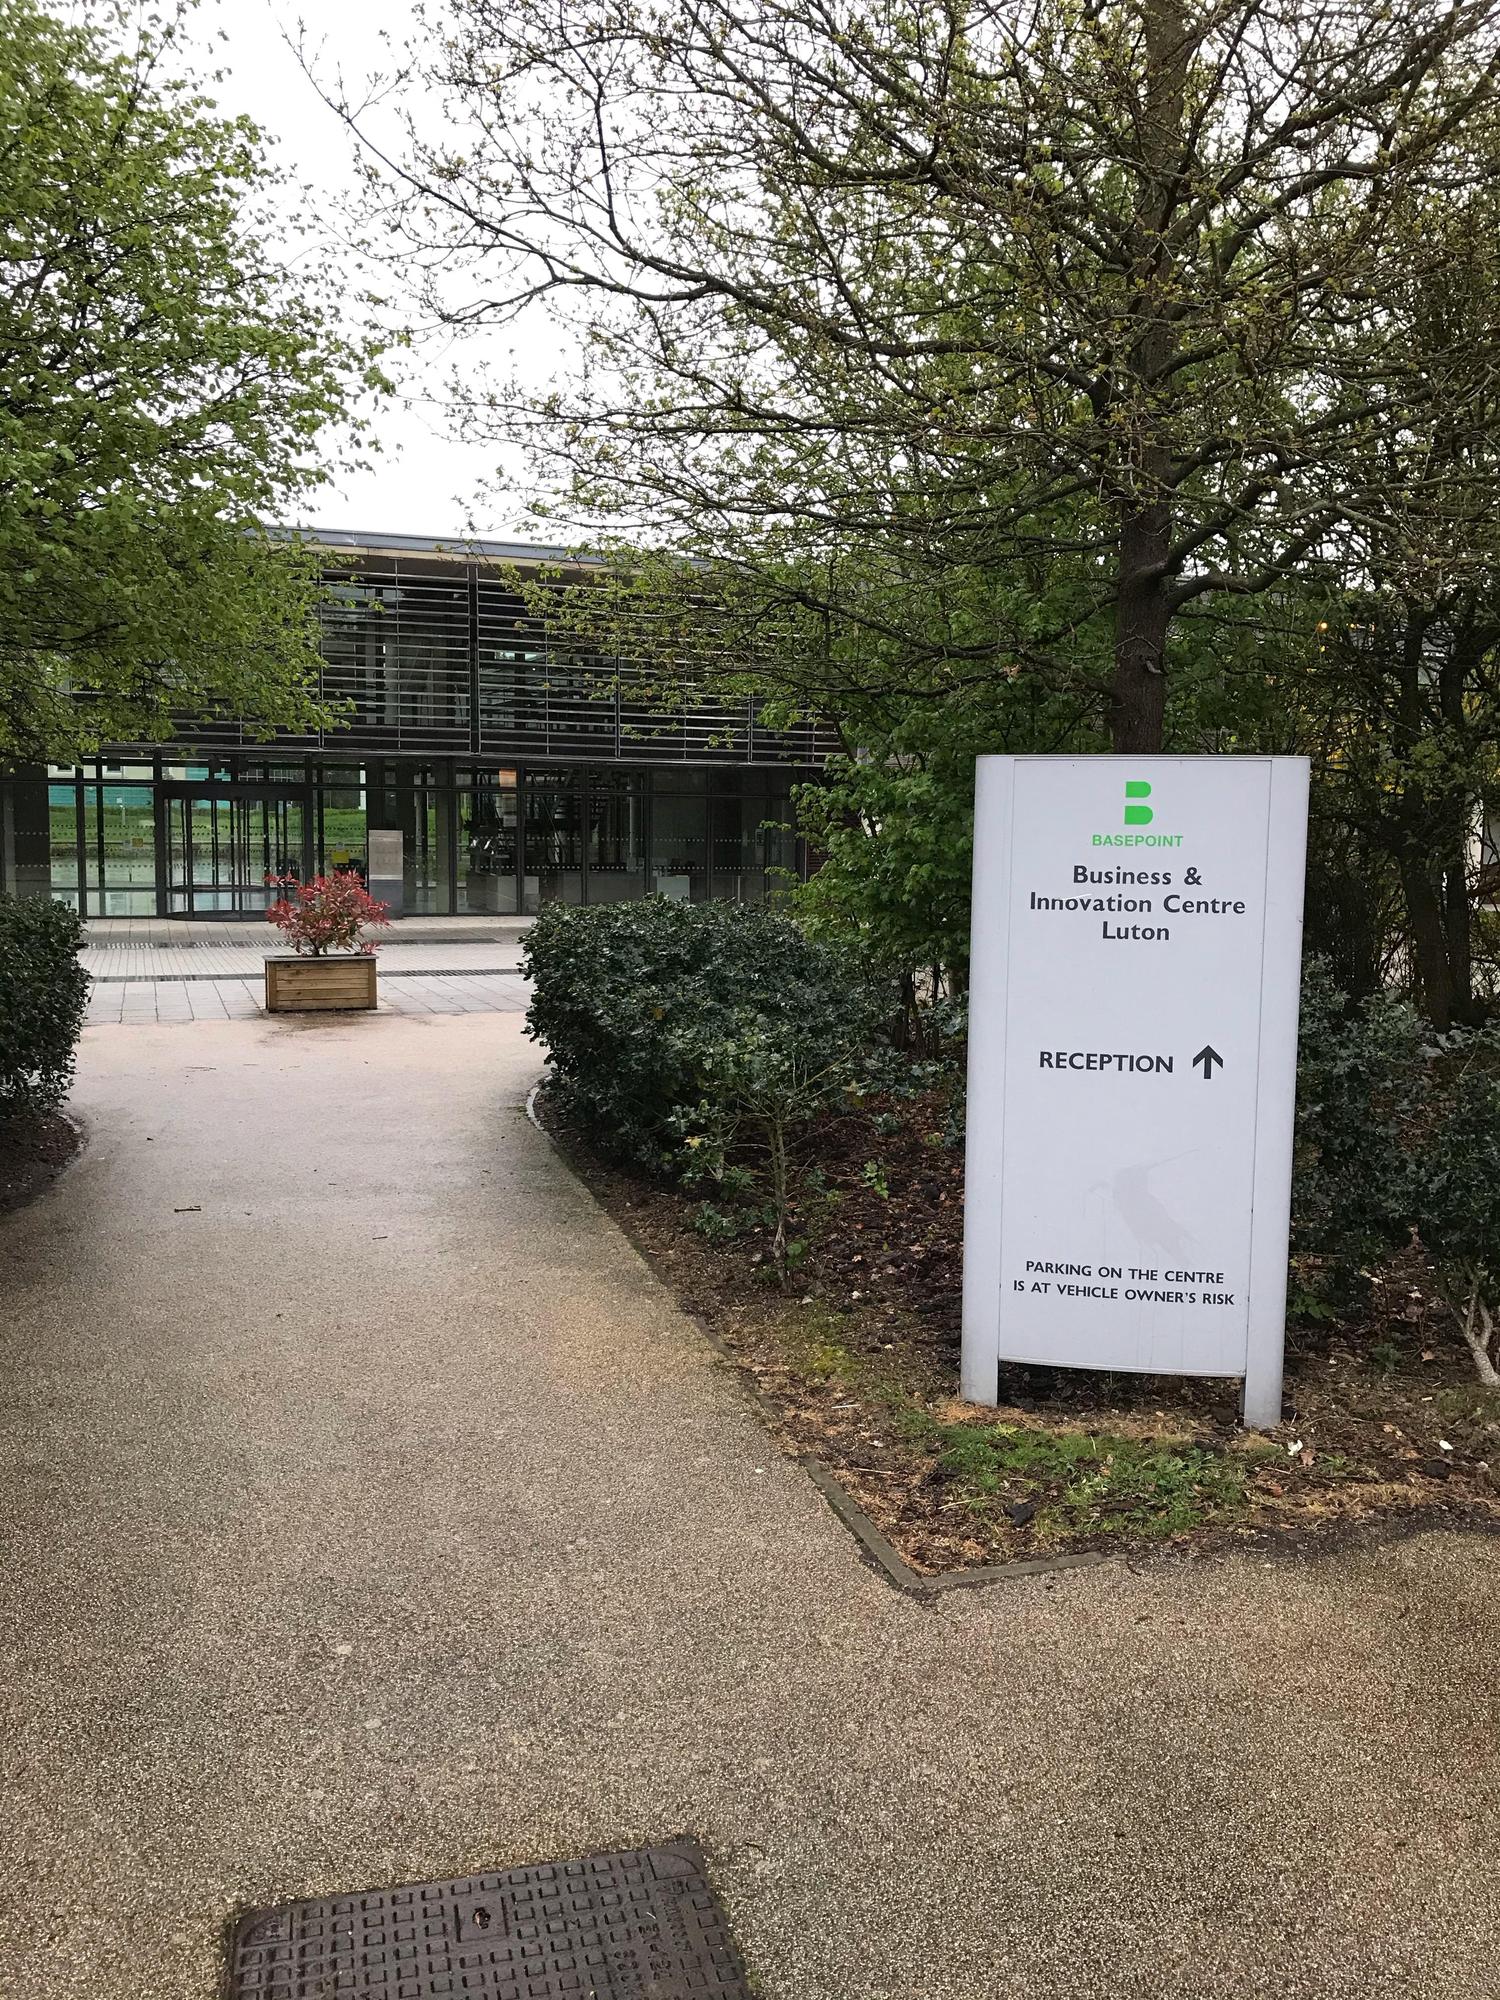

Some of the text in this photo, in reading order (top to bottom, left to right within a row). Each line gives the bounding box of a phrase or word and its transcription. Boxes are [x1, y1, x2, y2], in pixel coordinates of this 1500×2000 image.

[1092, 834, 1184, 847] BASEPOINT
[1073, 865, 1203, 886] Business &
[1030, 891, 1246, 915] Innovation Centre
[1102, 920, 1170, 941] Luton
[1039, 1051, 1174, 1074] RECEPTION
[1026, 1260, 1225, 1284] PARKING ON THE CENTRE
[1013, 1279, 1236, 1306] IS AT VEHICLE OWNER'S RISK
